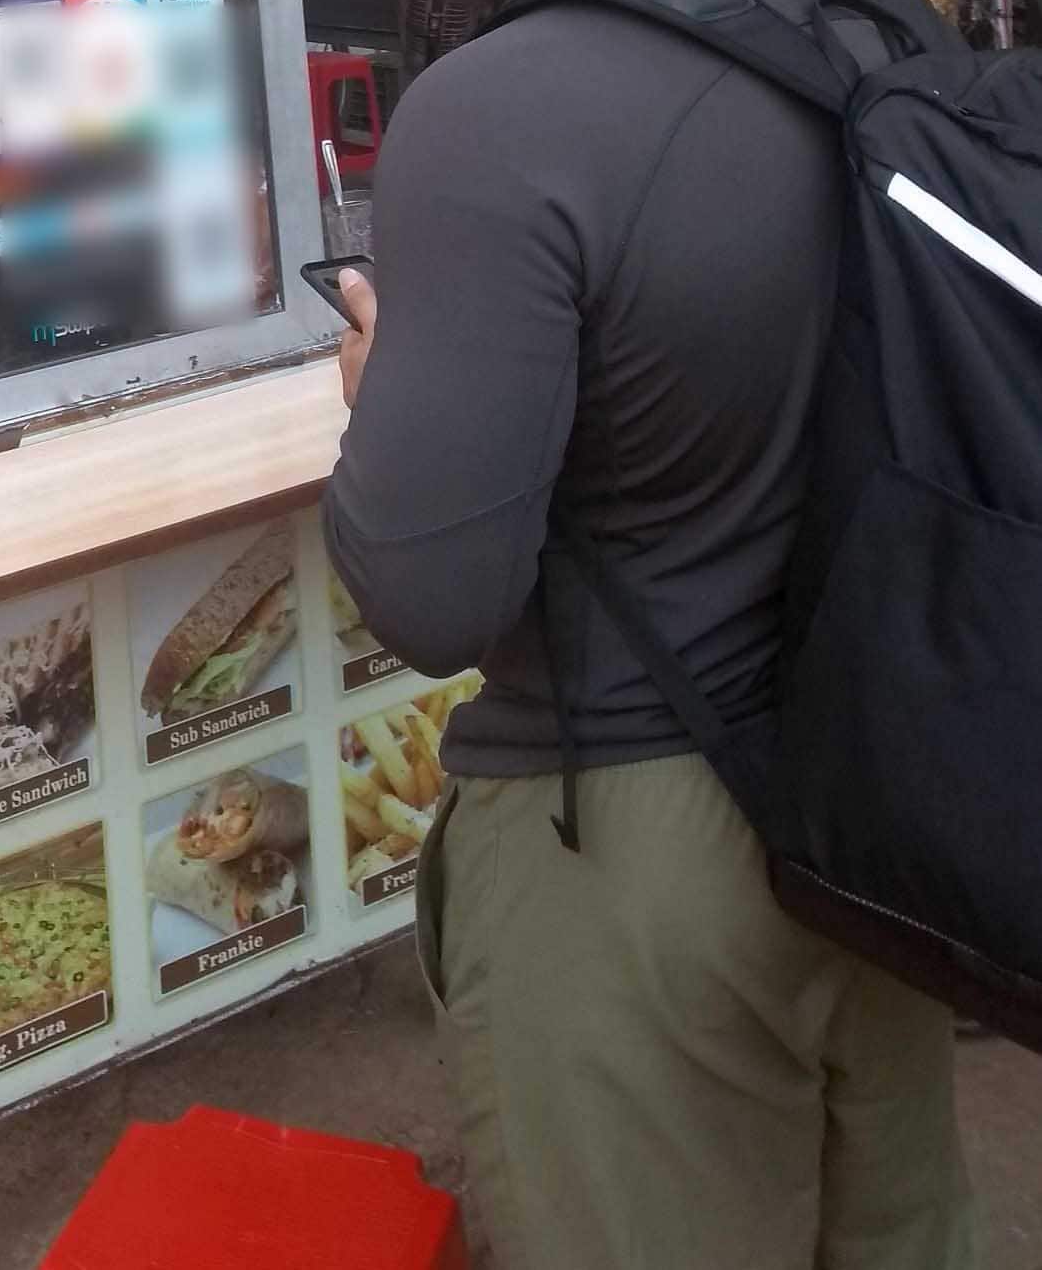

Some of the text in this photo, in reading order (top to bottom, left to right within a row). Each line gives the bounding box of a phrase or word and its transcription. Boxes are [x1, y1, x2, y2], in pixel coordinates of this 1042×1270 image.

[170, 700, 270, 749] Sub Sandwich
[11, 767, 87, 809] Sandwich
[198, 934, 264, 973] Frankie
[16, 1019, 67, 1051] Pizza
